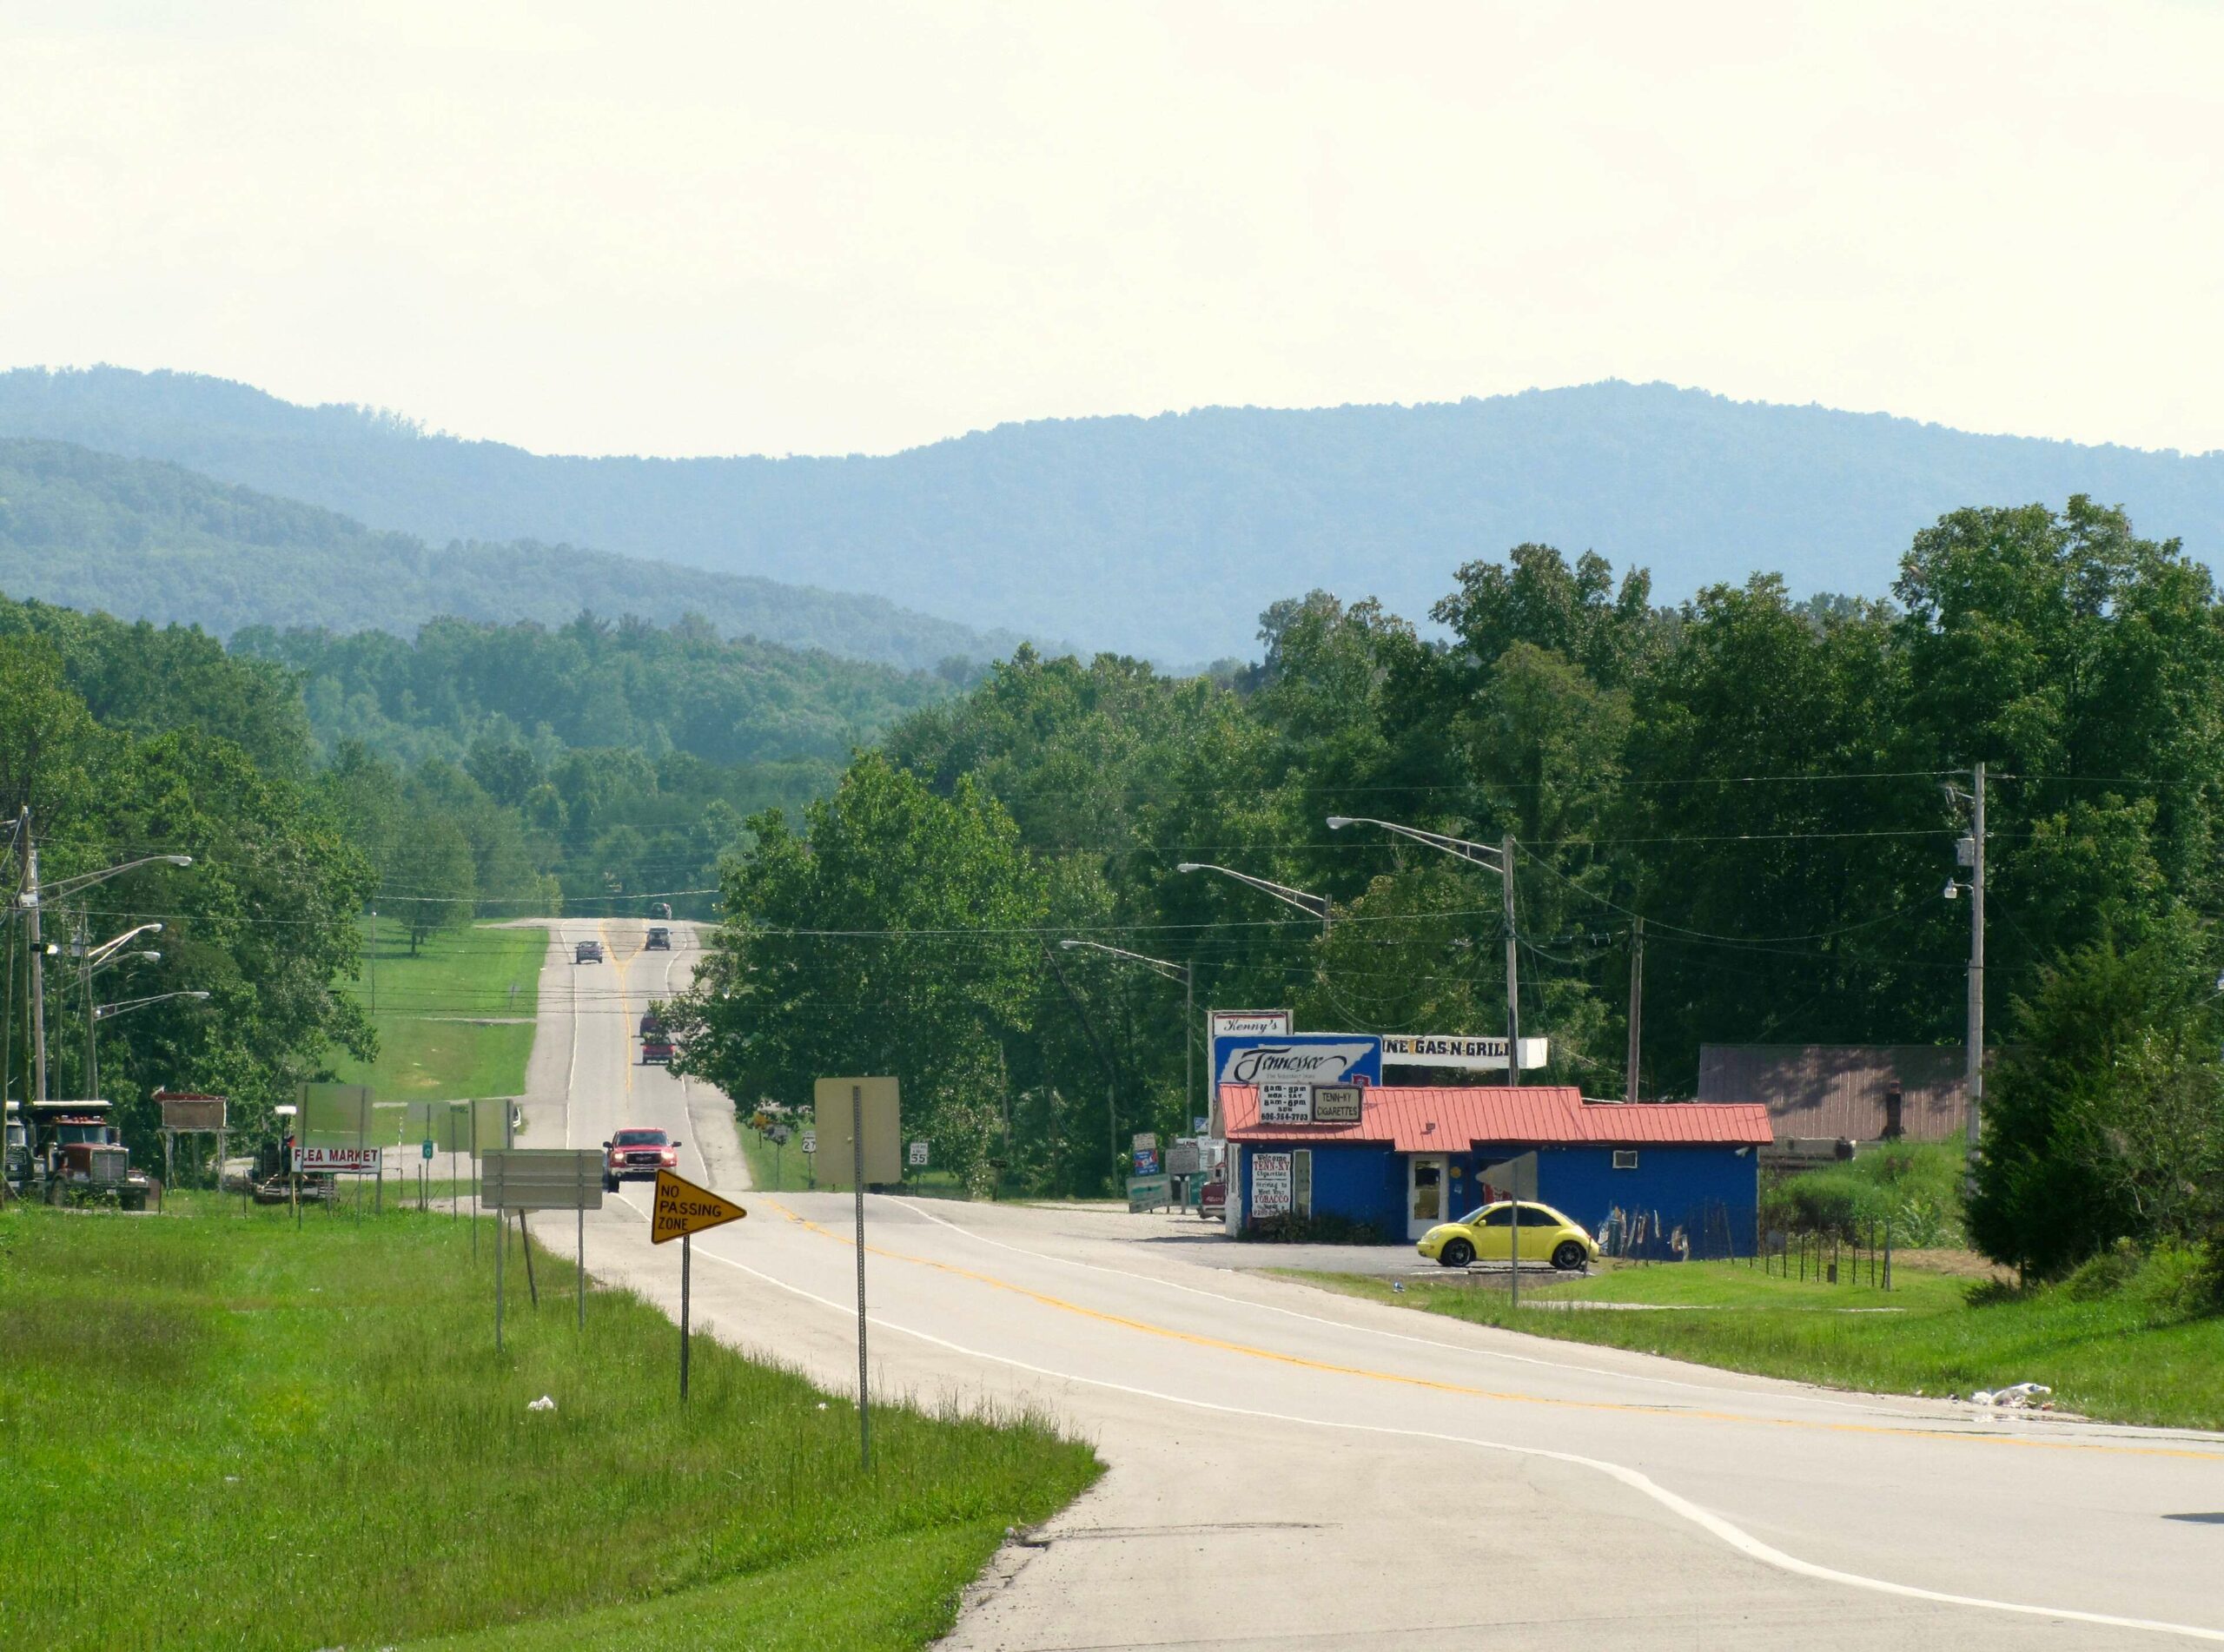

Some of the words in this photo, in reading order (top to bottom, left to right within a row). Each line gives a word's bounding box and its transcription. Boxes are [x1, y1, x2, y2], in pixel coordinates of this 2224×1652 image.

[1223, 1018, 1277, 1034] Kenny's
[1234, 1047, 1347, 1082] Tennessee
[1317, 1106, 1358, 1117] CIGARETTES
[804, 1140, 816, 1150] 27
[329, 1148, 378, 1162] MARKET
[911, 1153, 926, 1163] 55
[1254, 1160, 1290, 1171] TENN-KY
[660, 1185, 679, 1198] NO
[1254, 1195, 1288, 1204] TOBACCO
[659, 1200, 722, 1217] PASSING
[658, 1218, 688, 1231] ZONE
